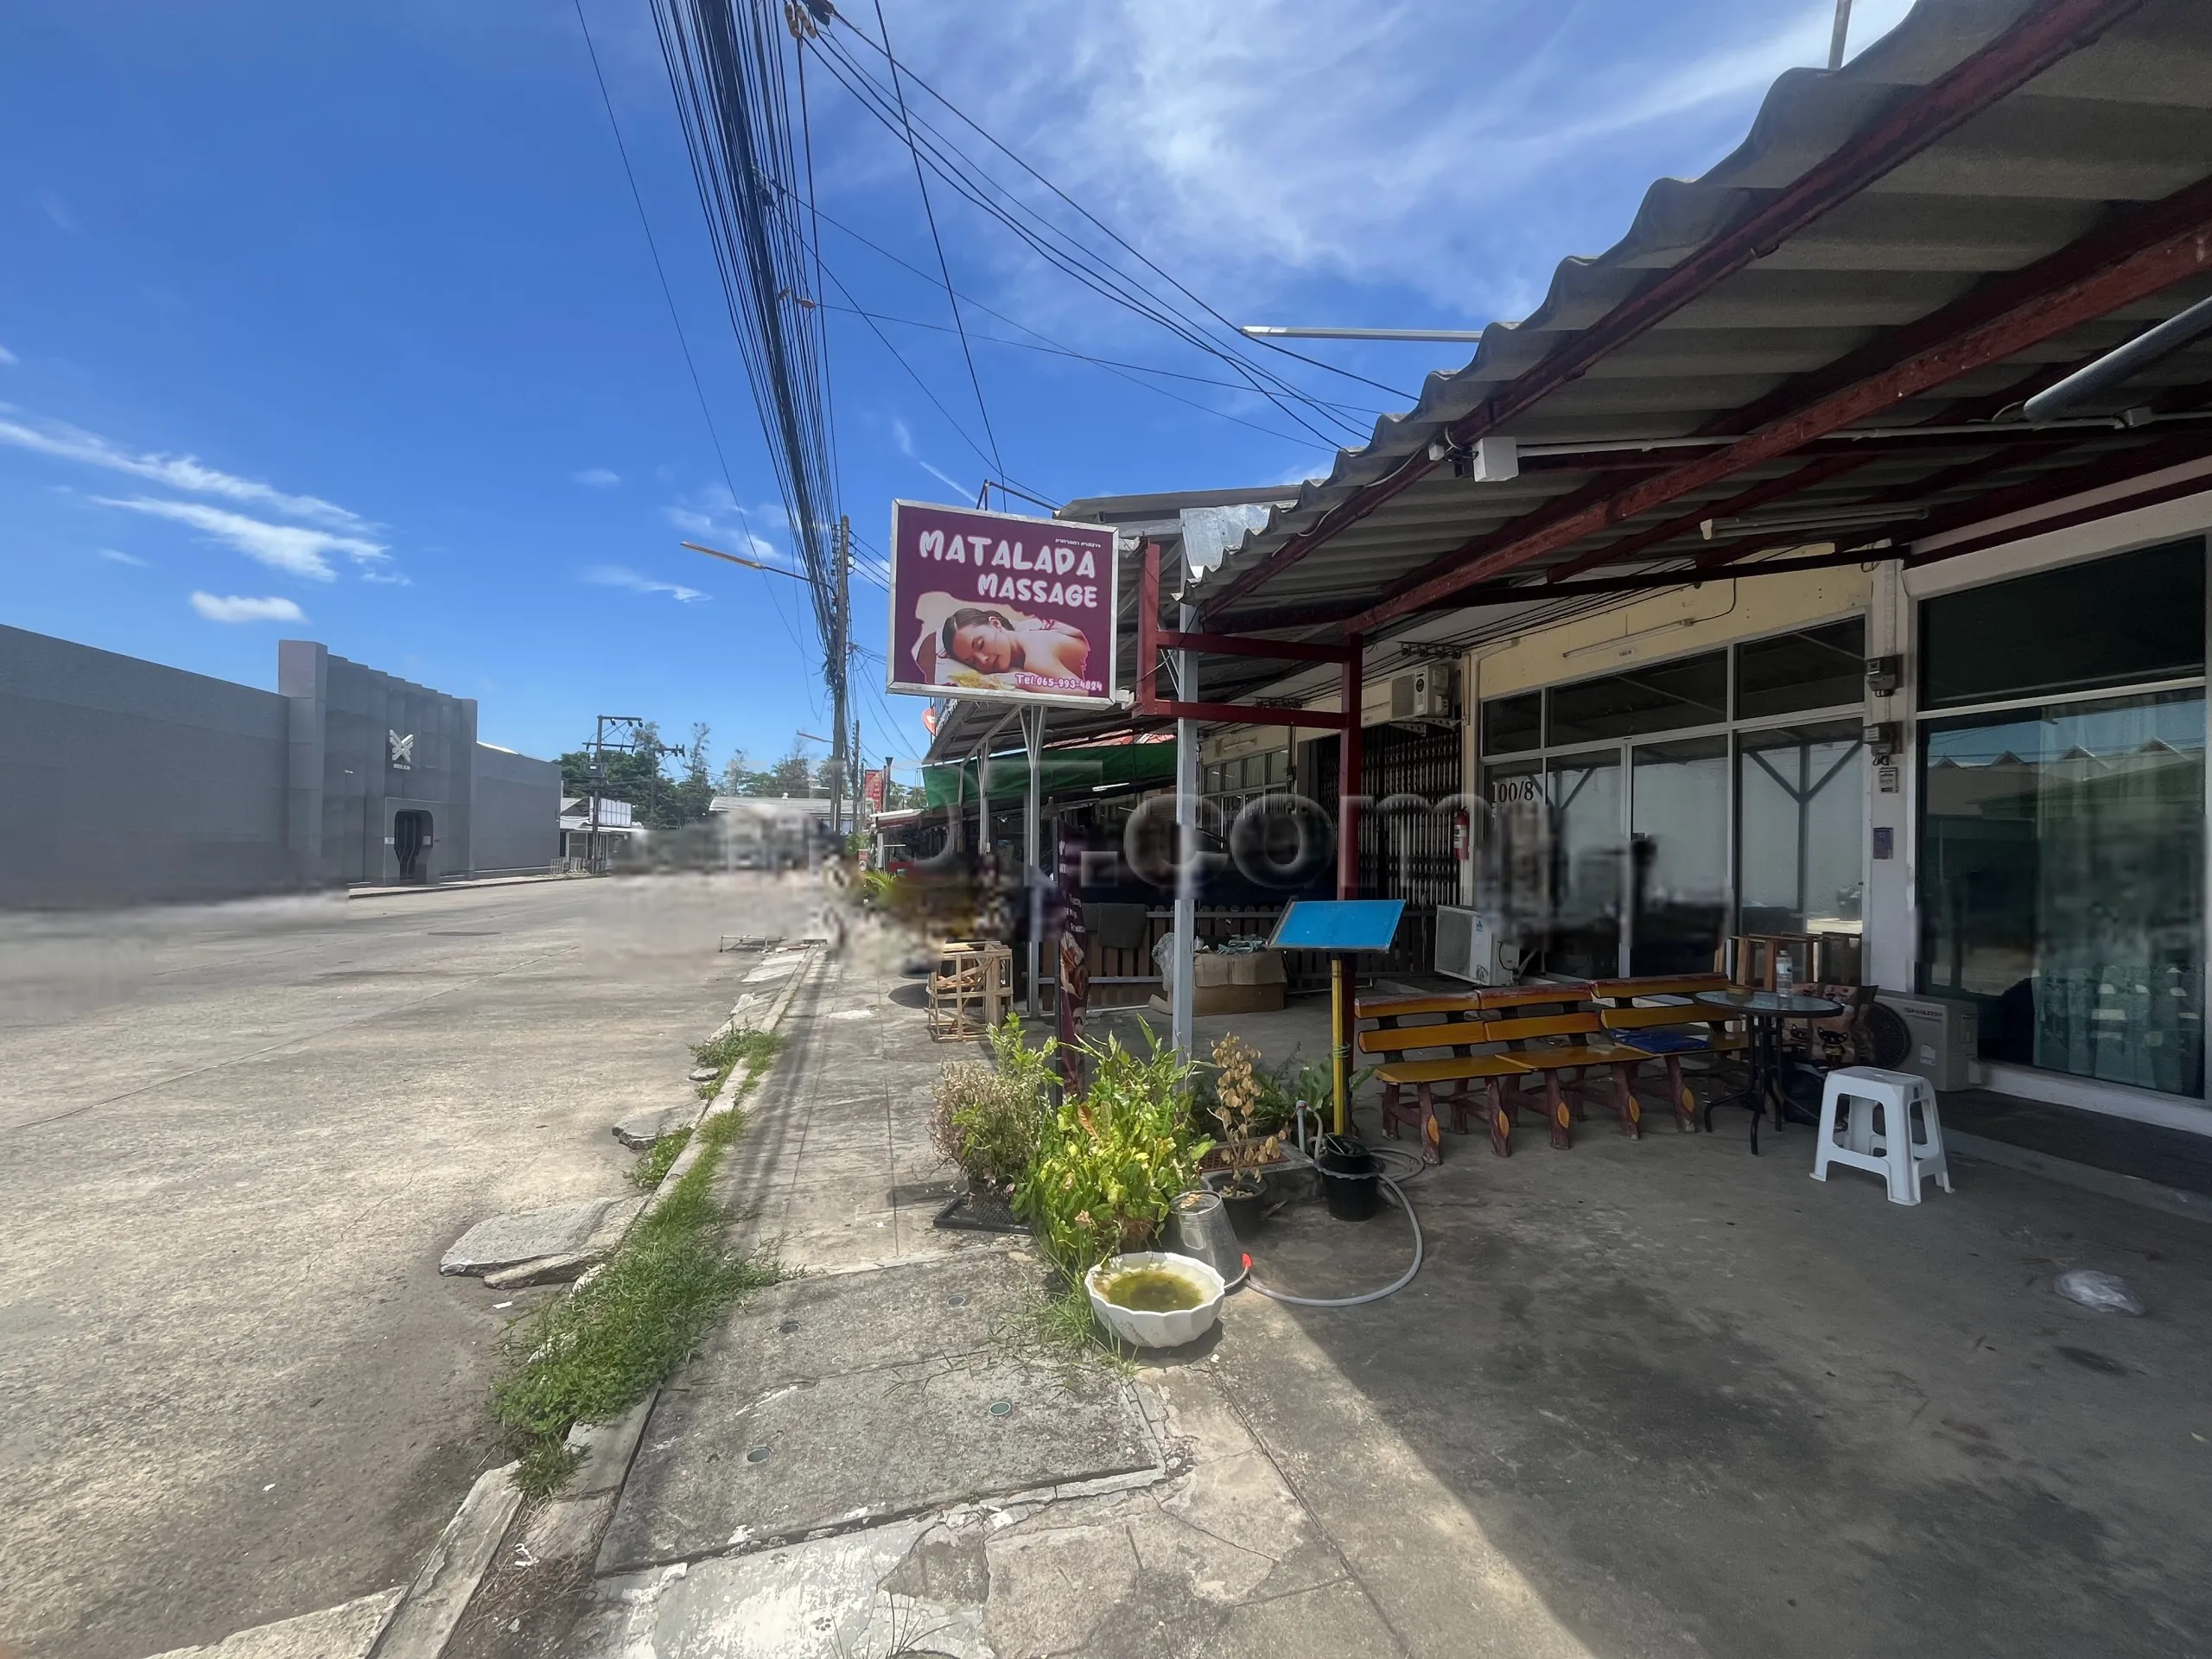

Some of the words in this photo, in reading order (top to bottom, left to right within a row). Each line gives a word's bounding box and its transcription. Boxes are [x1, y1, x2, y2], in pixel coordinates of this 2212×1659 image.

[918, 530, 1096, 579] MATALADA
[978, 573, 1097, 608] MASSAGE
[1904, 1007, 1943, 1017] SHARP
